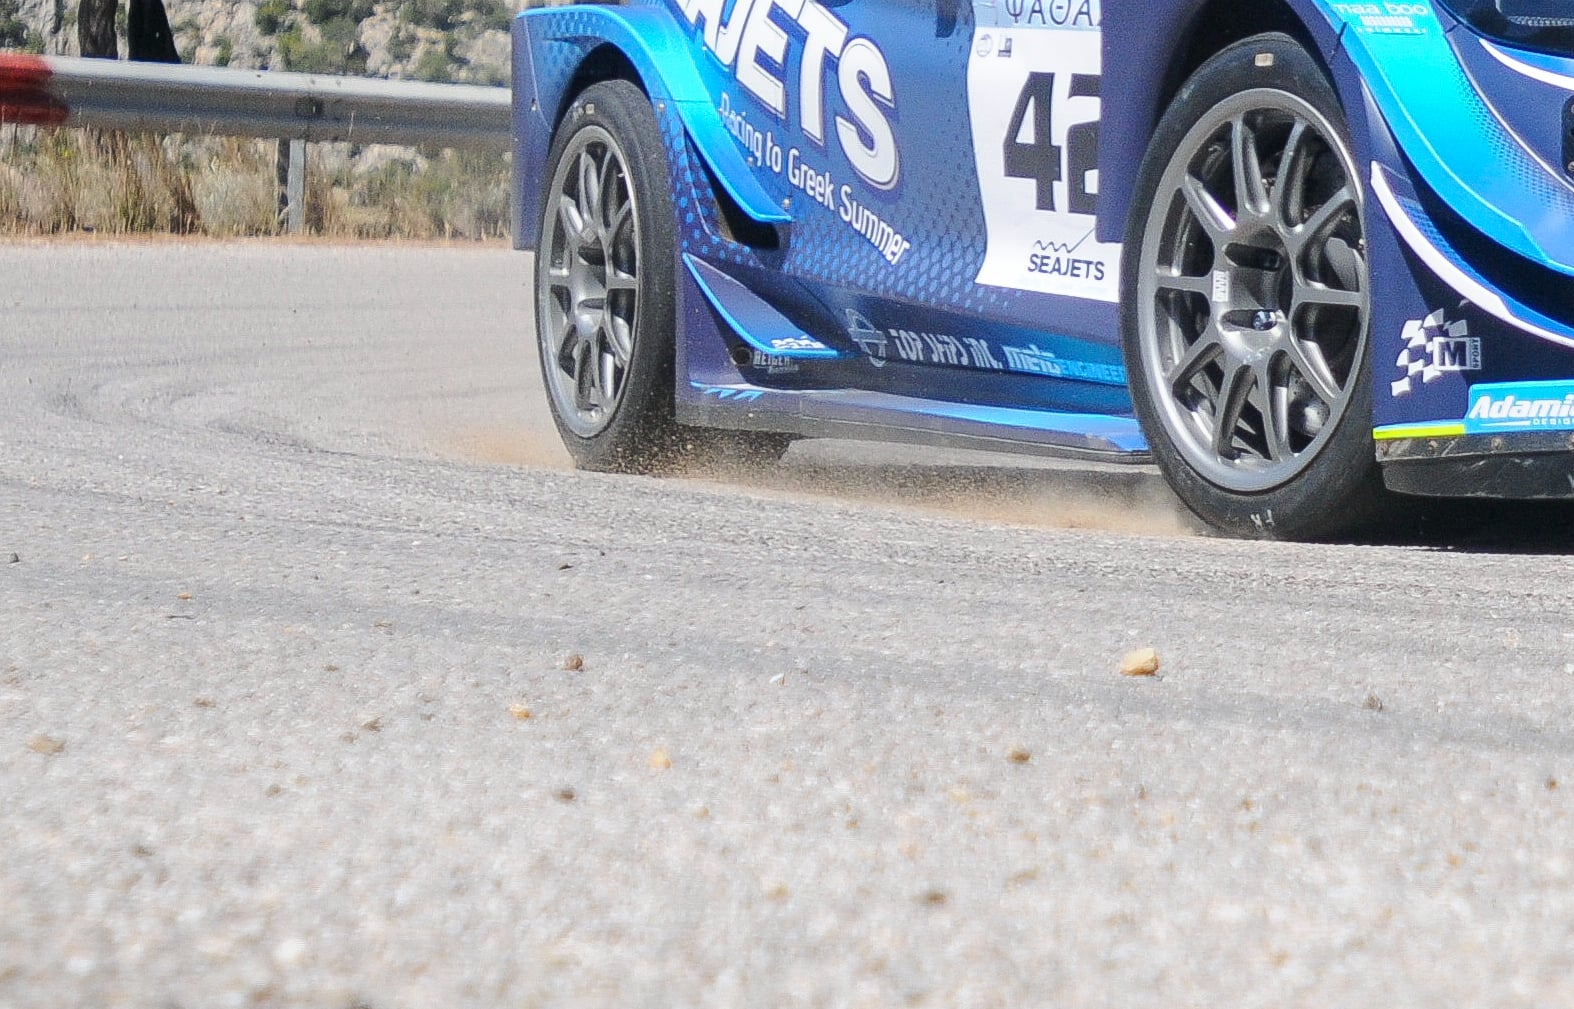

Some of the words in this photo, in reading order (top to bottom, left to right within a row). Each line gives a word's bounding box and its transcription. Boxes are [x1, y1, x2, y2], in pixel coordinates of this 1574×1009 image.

[766, 130, 782, 174] to
[788, 147, 835, 211] Greek
[839, 184, 911, 266] Summer
[1027, 253, 1105, 281] SEAJETS
